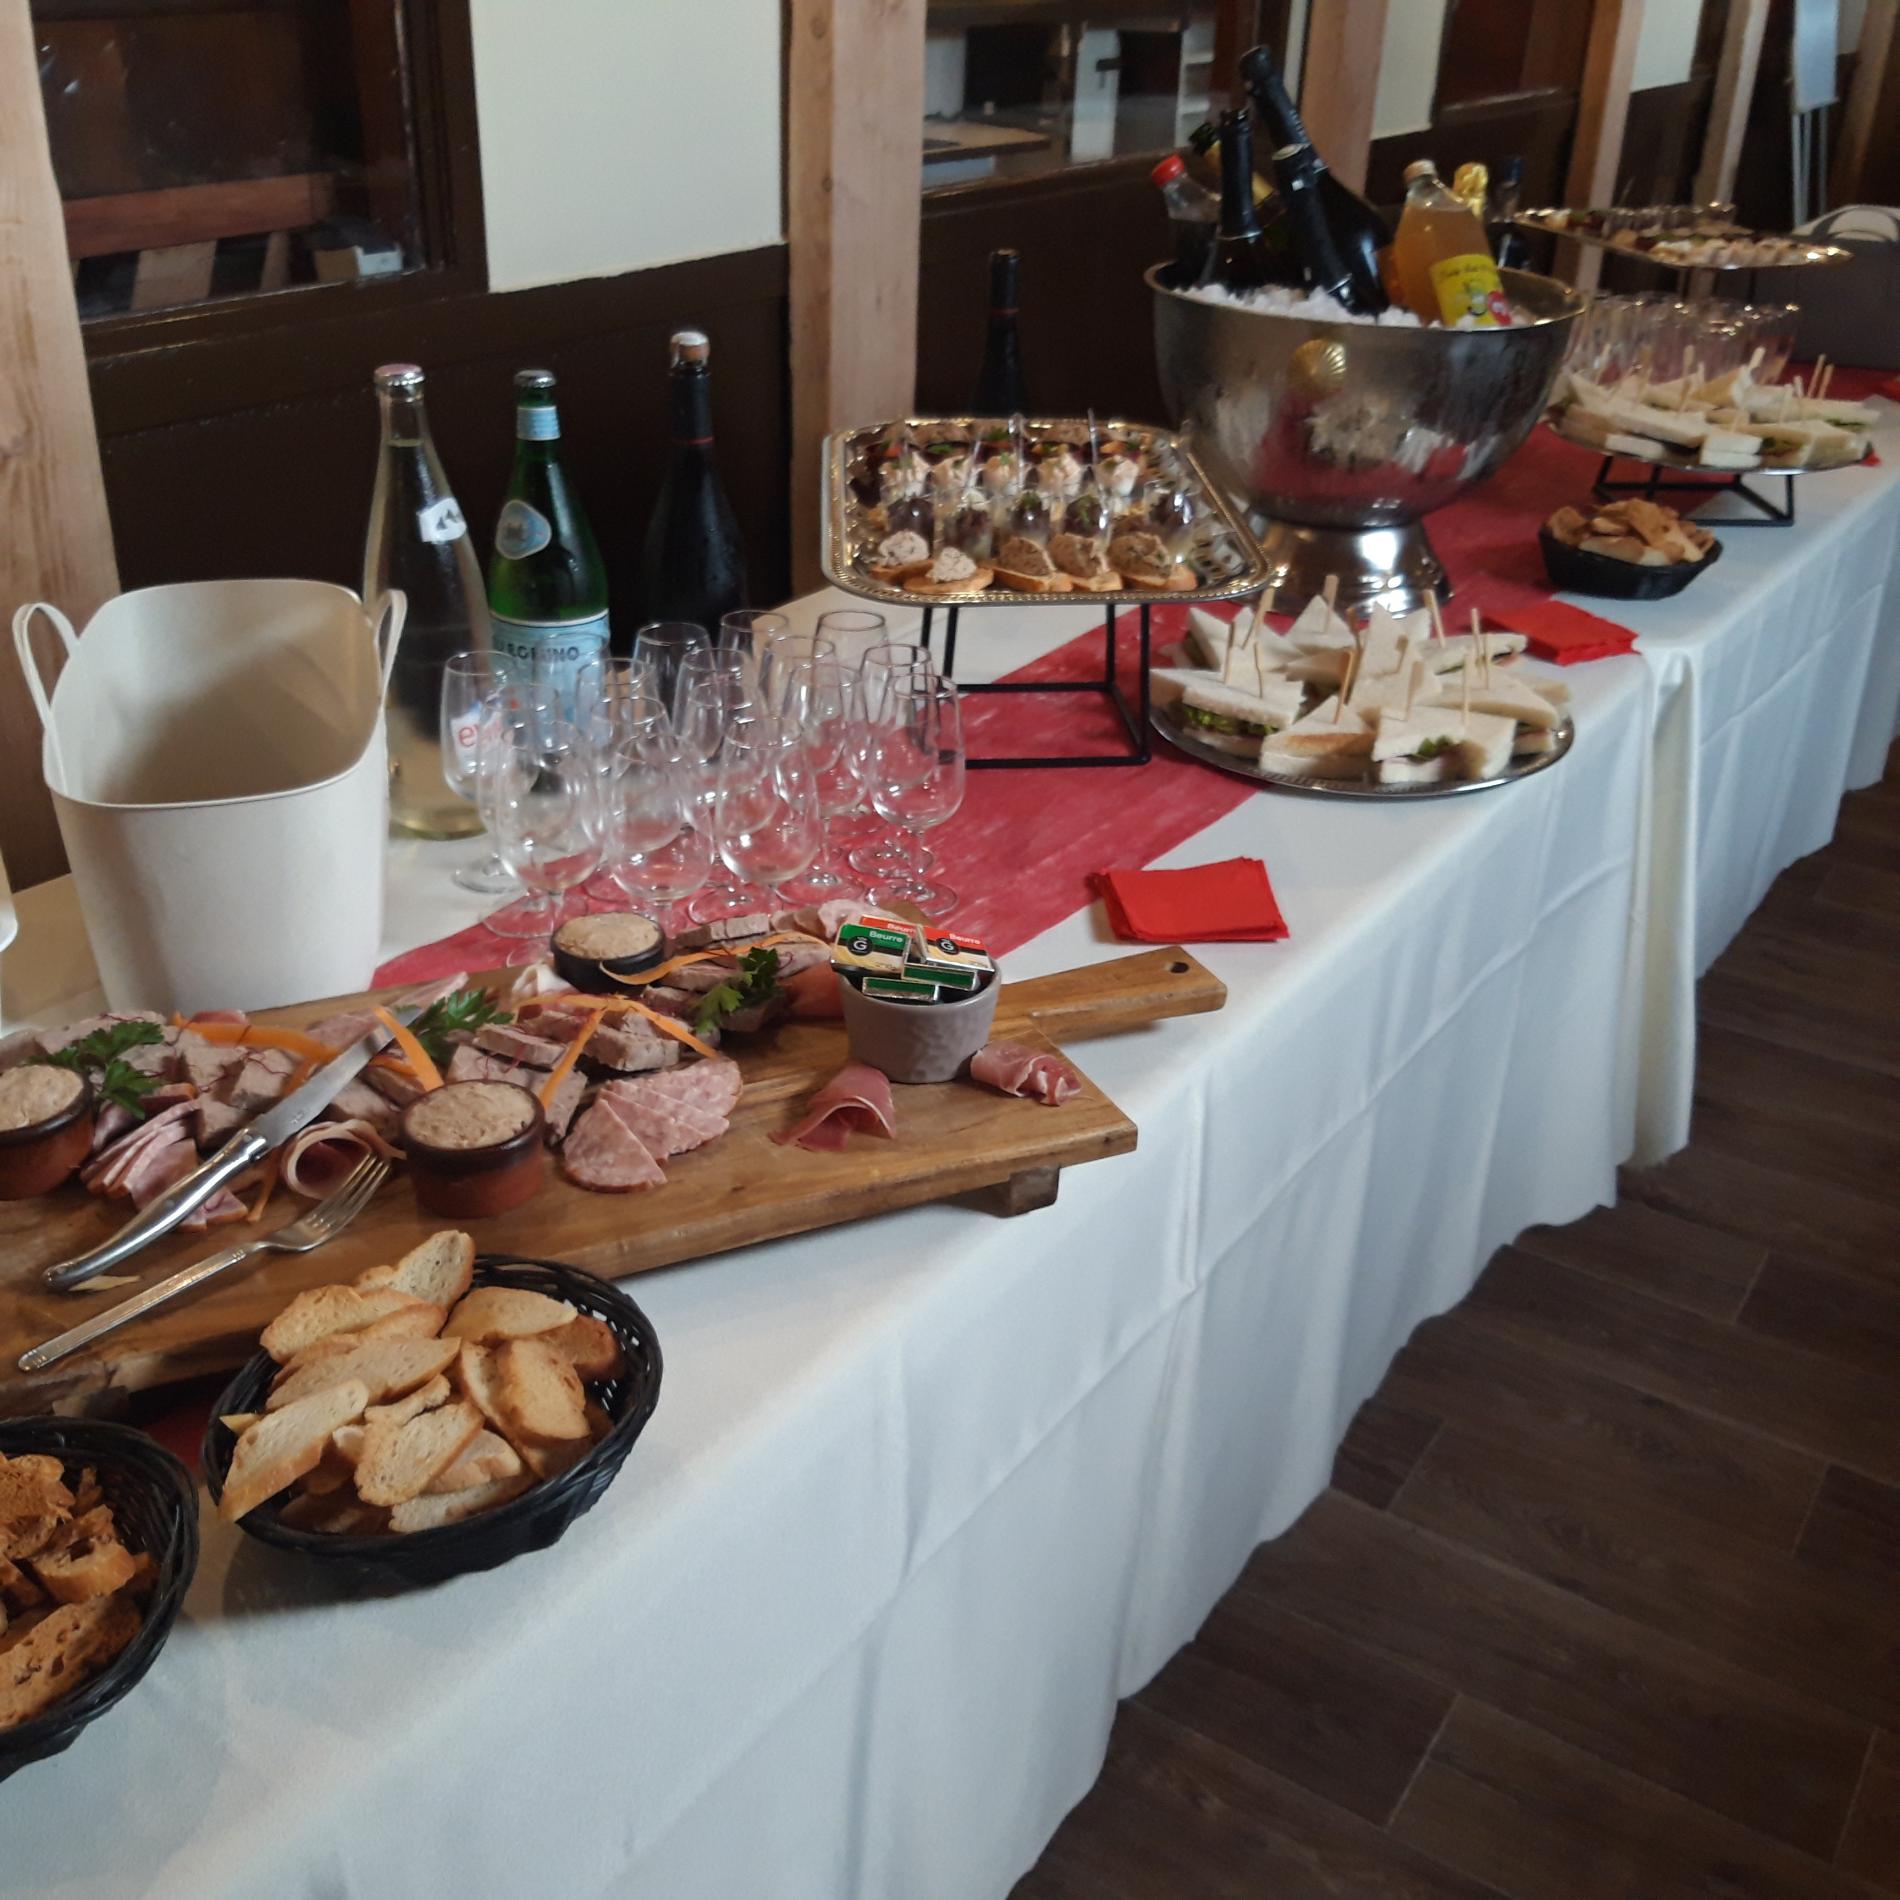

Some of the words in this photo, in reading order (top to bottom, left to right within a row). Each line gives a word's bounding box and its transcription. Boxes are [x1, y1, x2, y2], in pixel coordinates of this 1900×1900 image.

[868, 930, 904, 943] Beurre
[948, 932, 982, 945] Beurre
[853, 940, 868, 951] G
